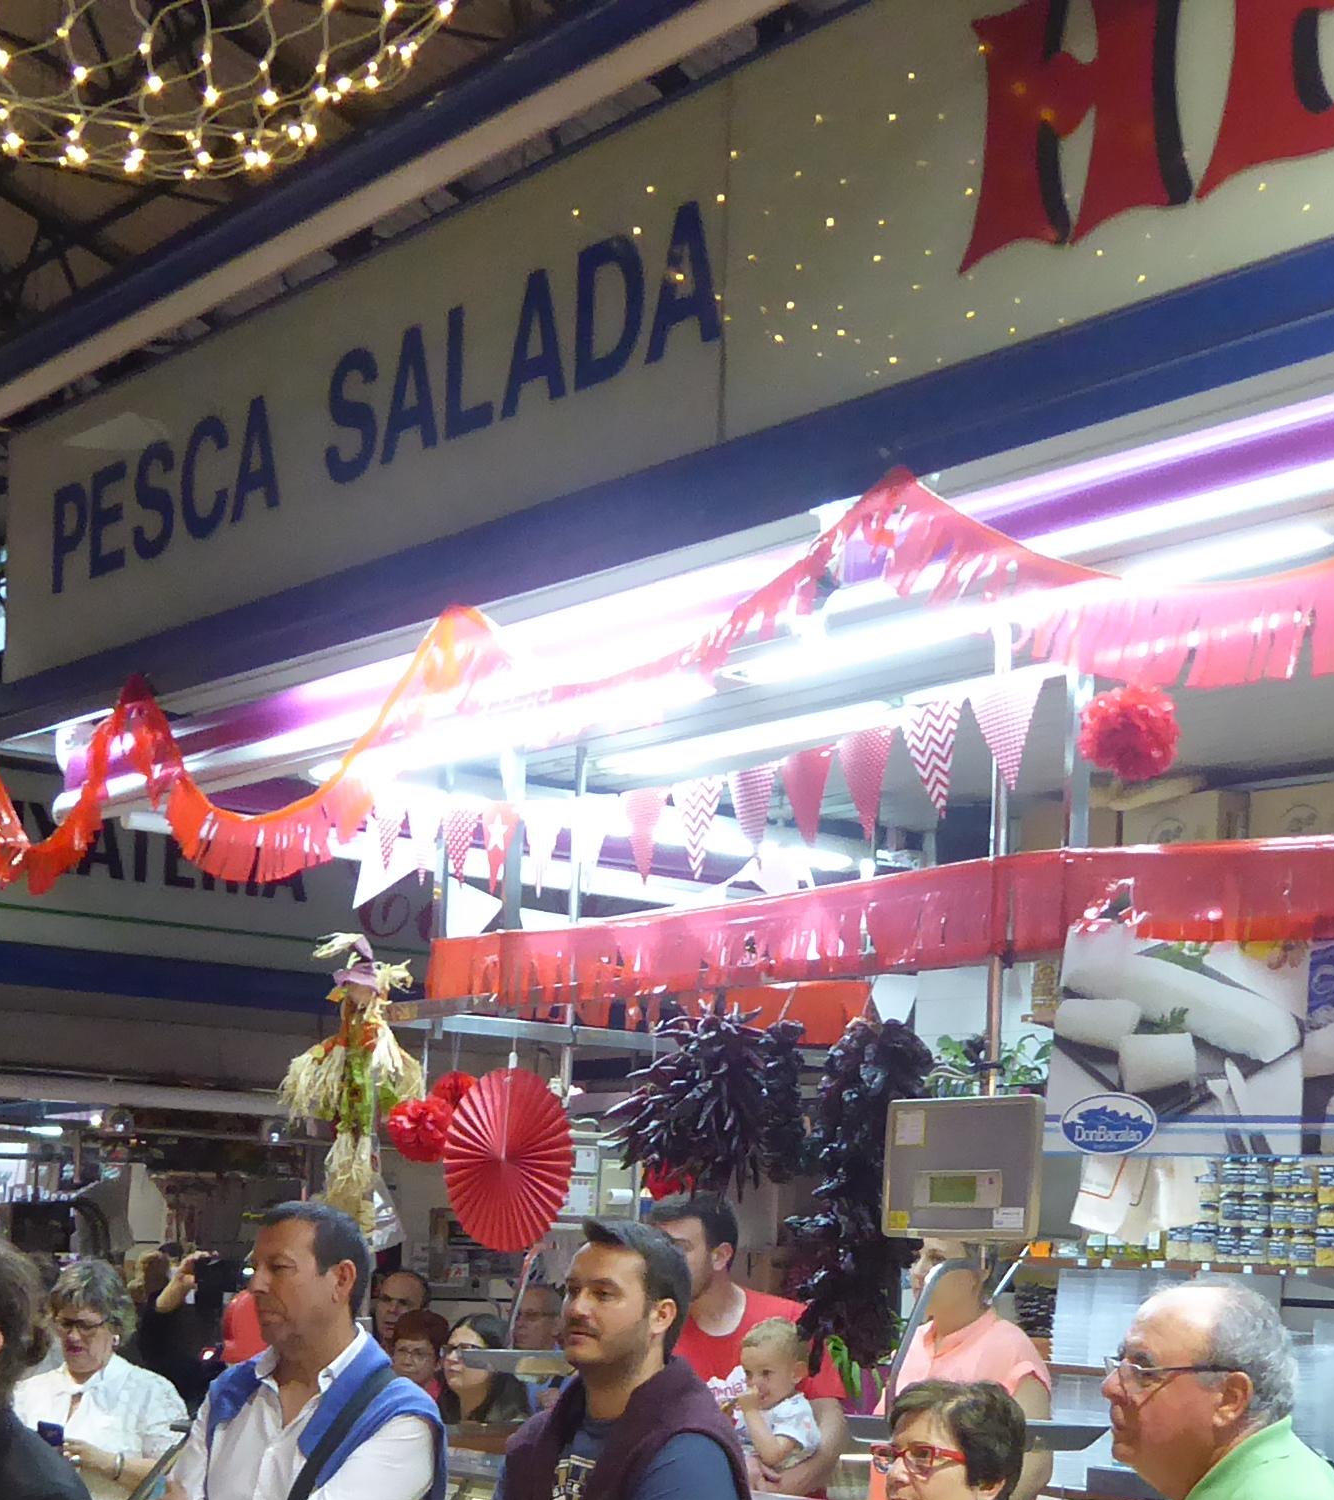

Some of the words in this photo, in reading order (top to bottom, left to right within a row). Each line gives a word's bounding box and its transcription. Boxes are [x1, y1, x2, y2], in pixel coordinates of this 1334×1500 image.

[52, 393, 280, 594] PESCA
[324, 200, 720, 485] SALADA
[1074, 1125, 1143, 1144] DonBacalao
